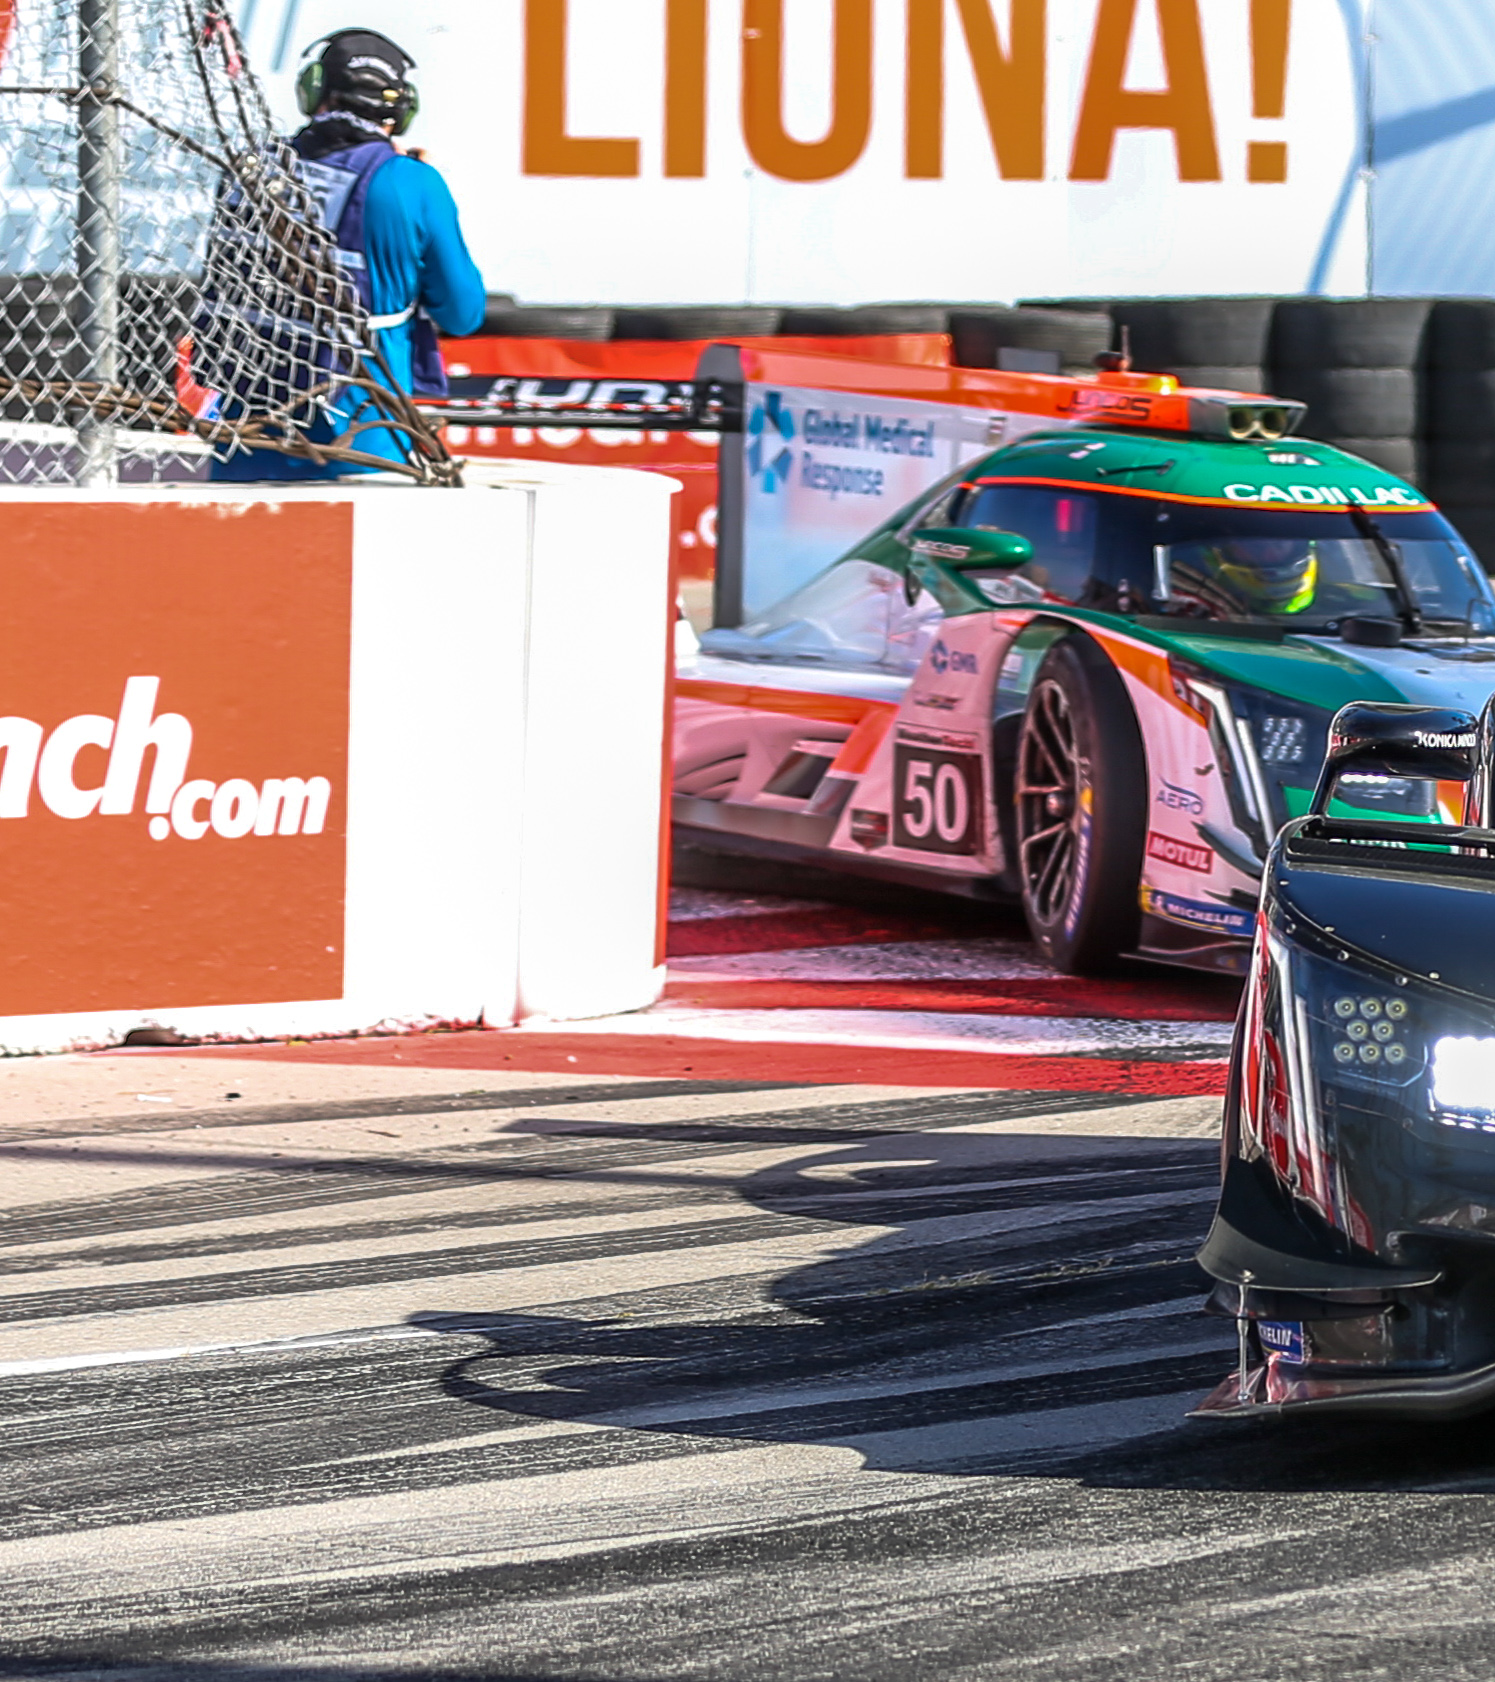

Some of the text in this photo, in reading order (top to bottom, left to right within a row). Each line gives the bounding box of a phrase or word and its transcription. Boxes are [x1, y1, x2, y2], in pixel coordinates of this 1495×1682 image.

[1223, 483, 1421, 507] CADILLAC
[903, 760, 969, 843] 50
[1152, 836, 1209, 870] MOTUL
